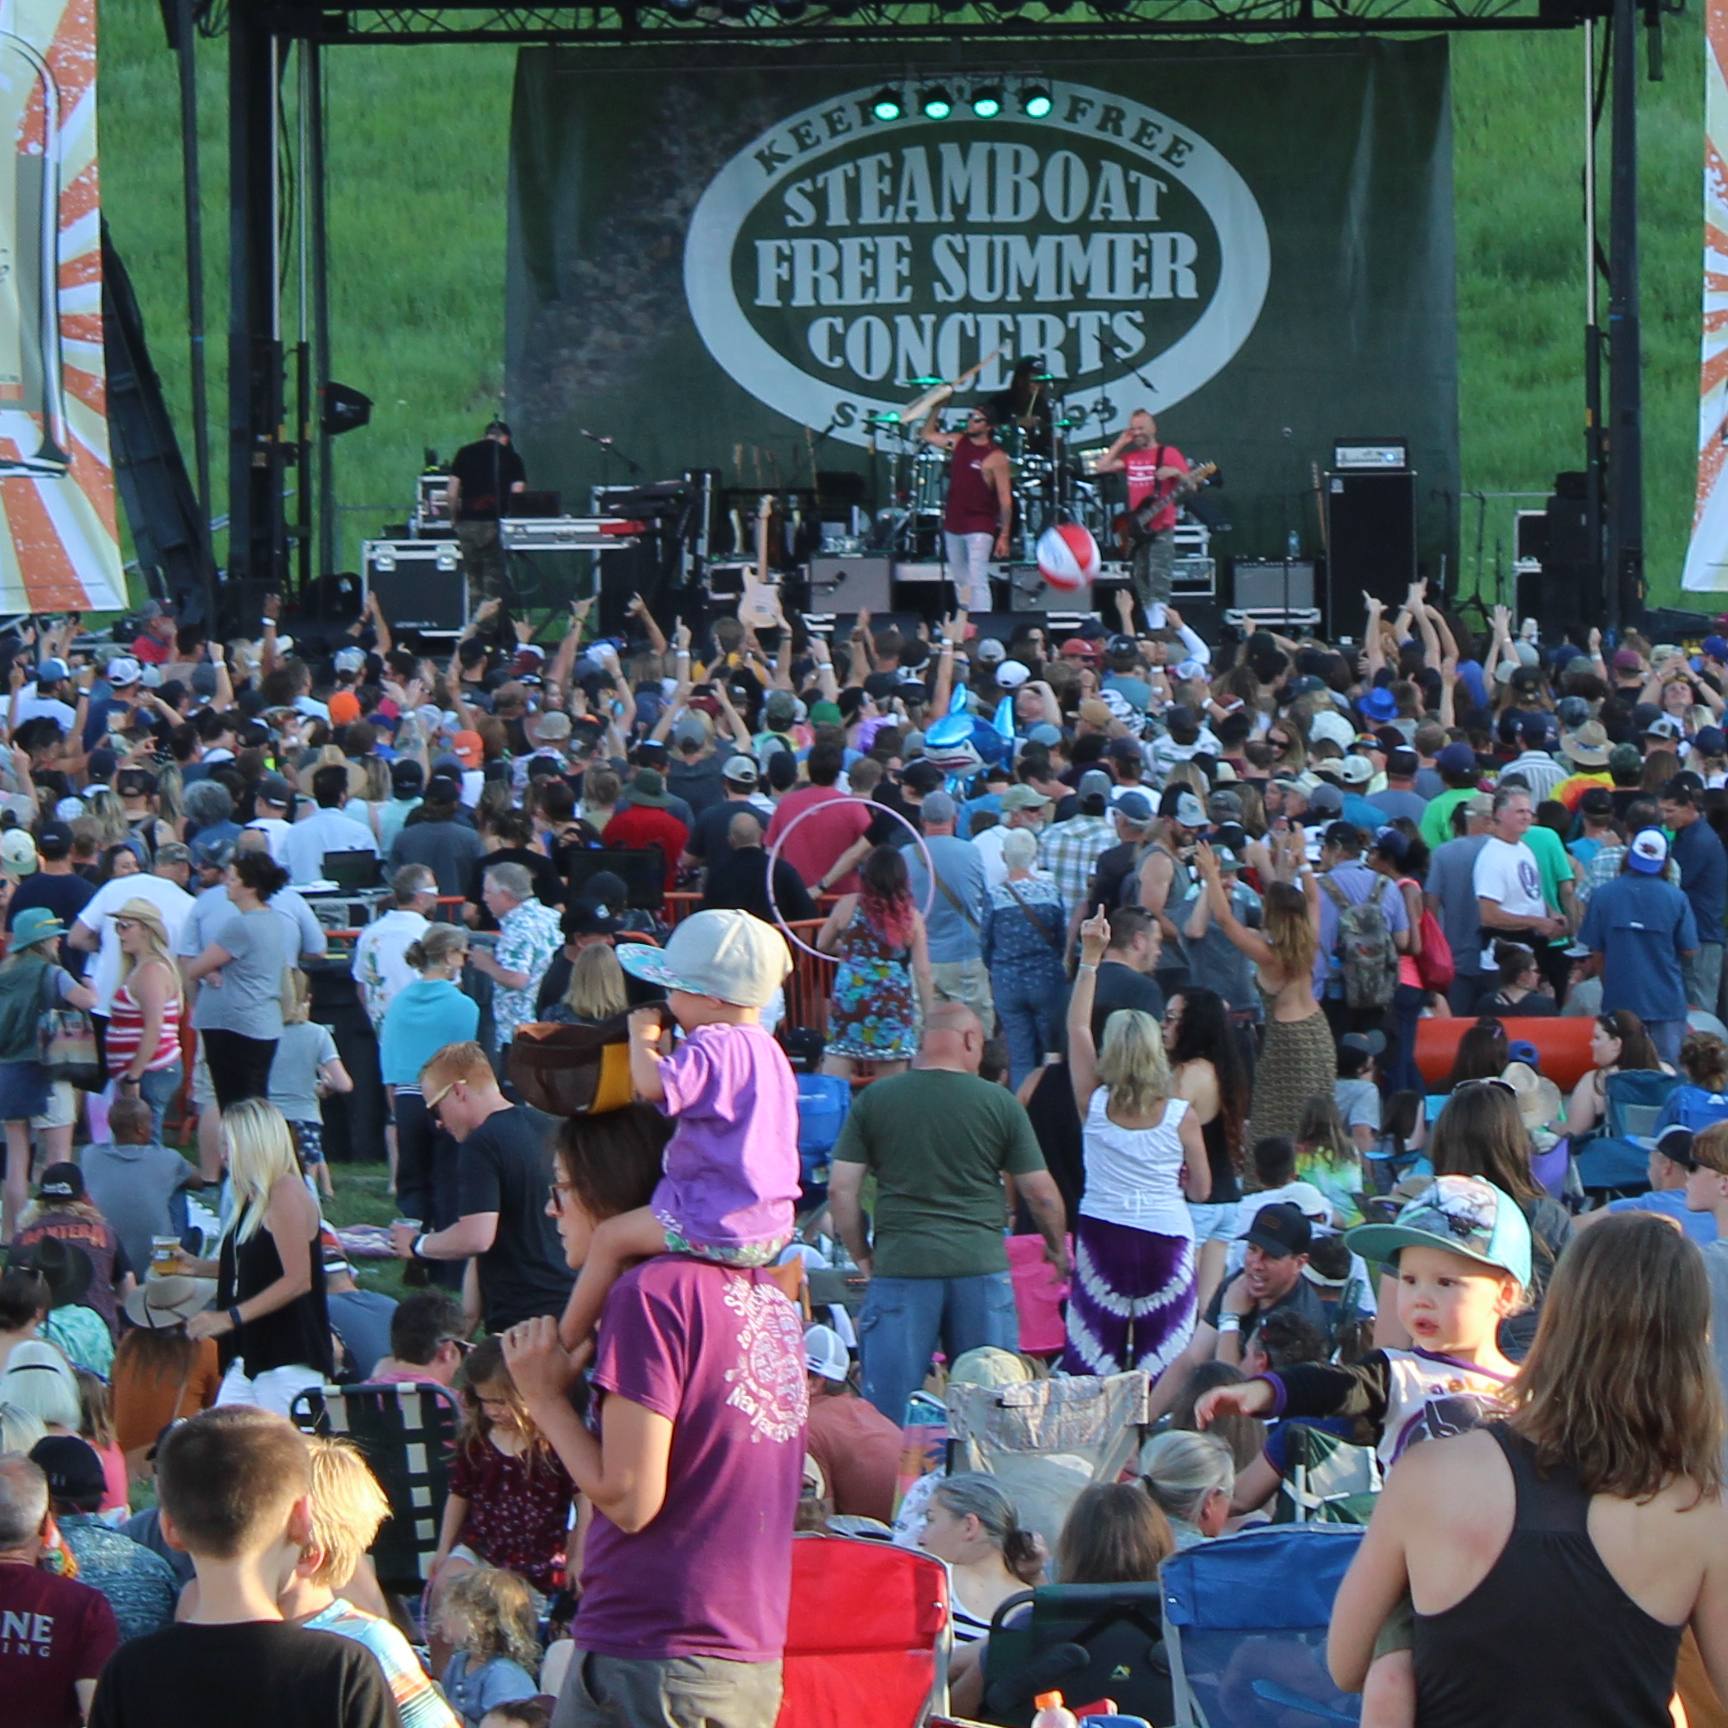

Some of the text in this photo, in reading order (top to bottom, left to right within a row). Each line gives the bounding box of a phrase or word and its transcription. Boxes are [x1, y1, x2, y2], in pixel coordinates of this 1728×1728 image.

[1063, 97, 1195, 170] FREE
[784, 141, 1168, 227] STEAMBOAT
[754, 231, 1199, 307] FREE SUMMER
[807, 310, 1146, 393] CONCERTS
